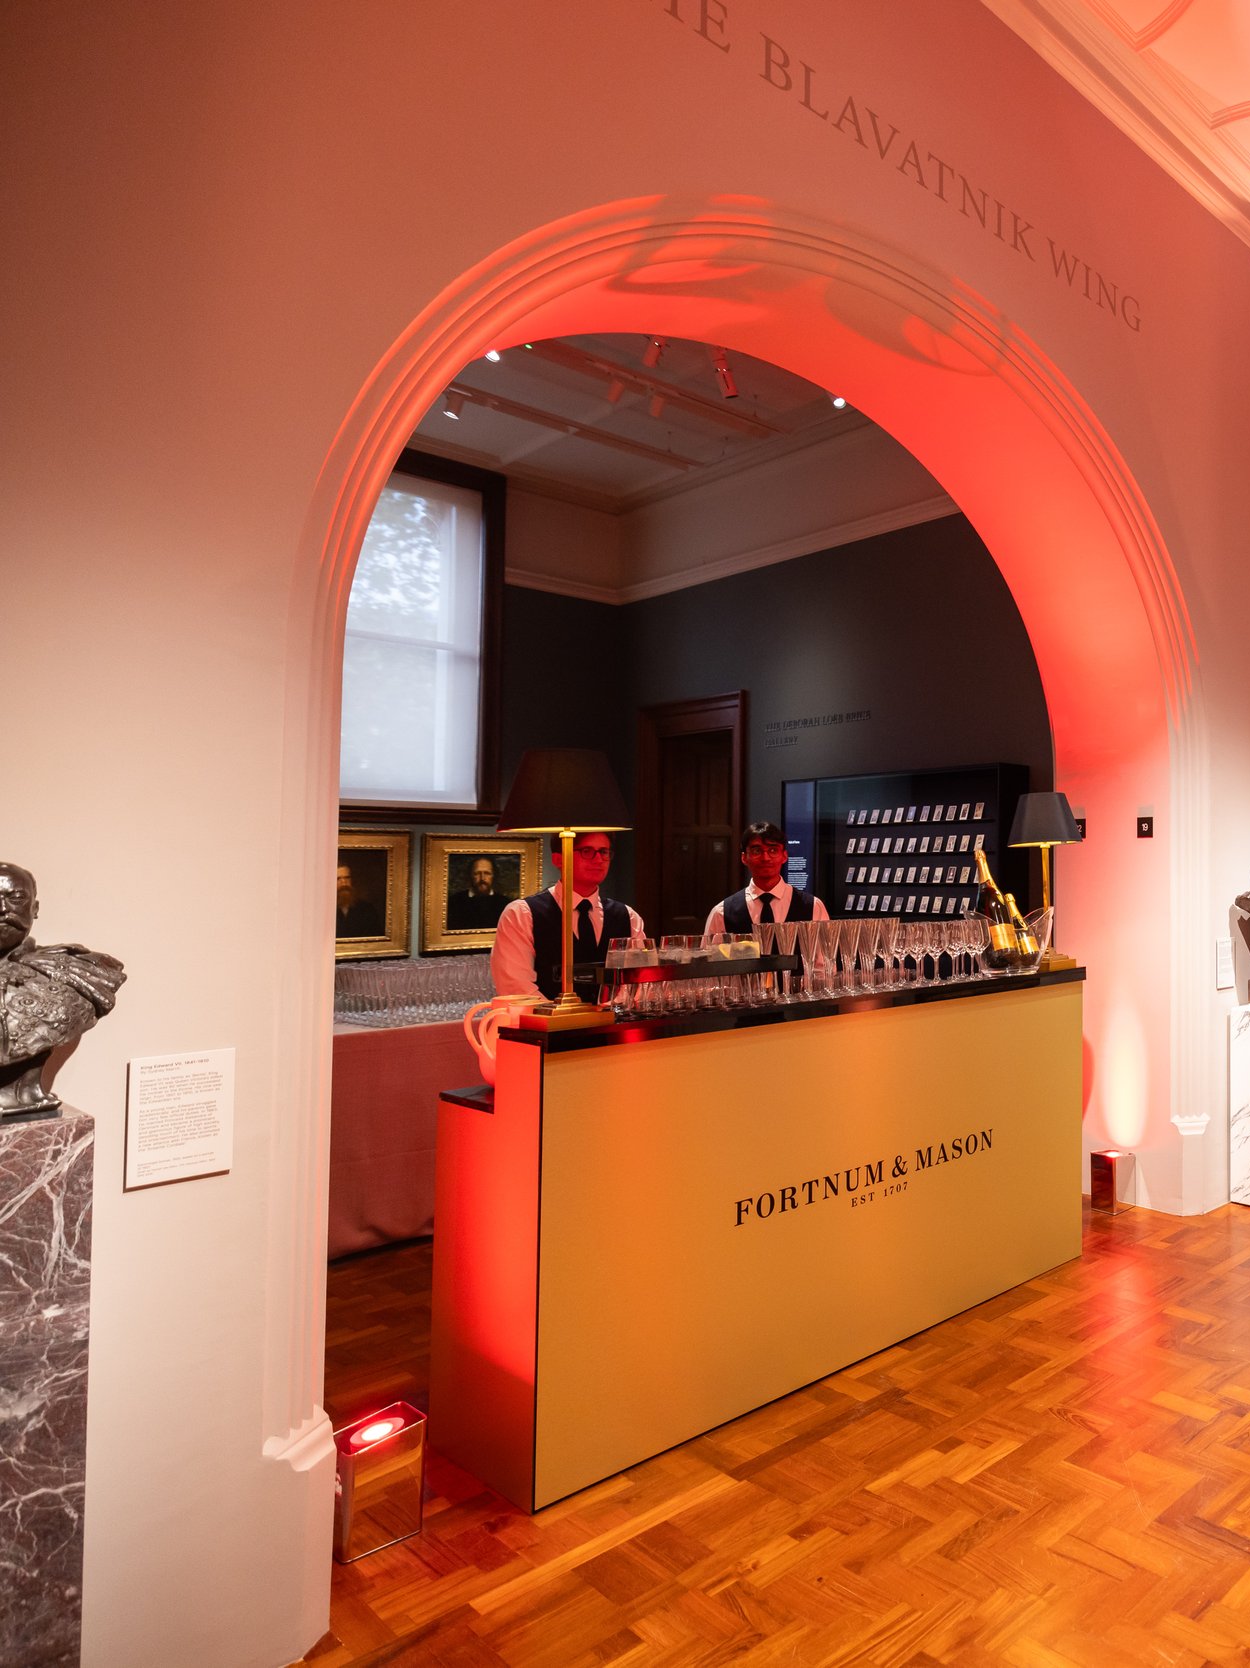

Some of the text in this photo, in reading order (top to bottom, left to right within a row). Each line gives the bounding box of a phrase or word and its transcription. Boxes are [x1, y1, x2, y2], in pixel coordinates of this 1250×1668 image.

[759, 31, 1036, 262] BLAVATNIK
[1047, 237, 1142, 332] WING
[1141, 823, 1149, 832] 19
[734, 1129, 993, 1227] FORTNUM & MASON
[851, 1181, 908, 1207] EST 1707
